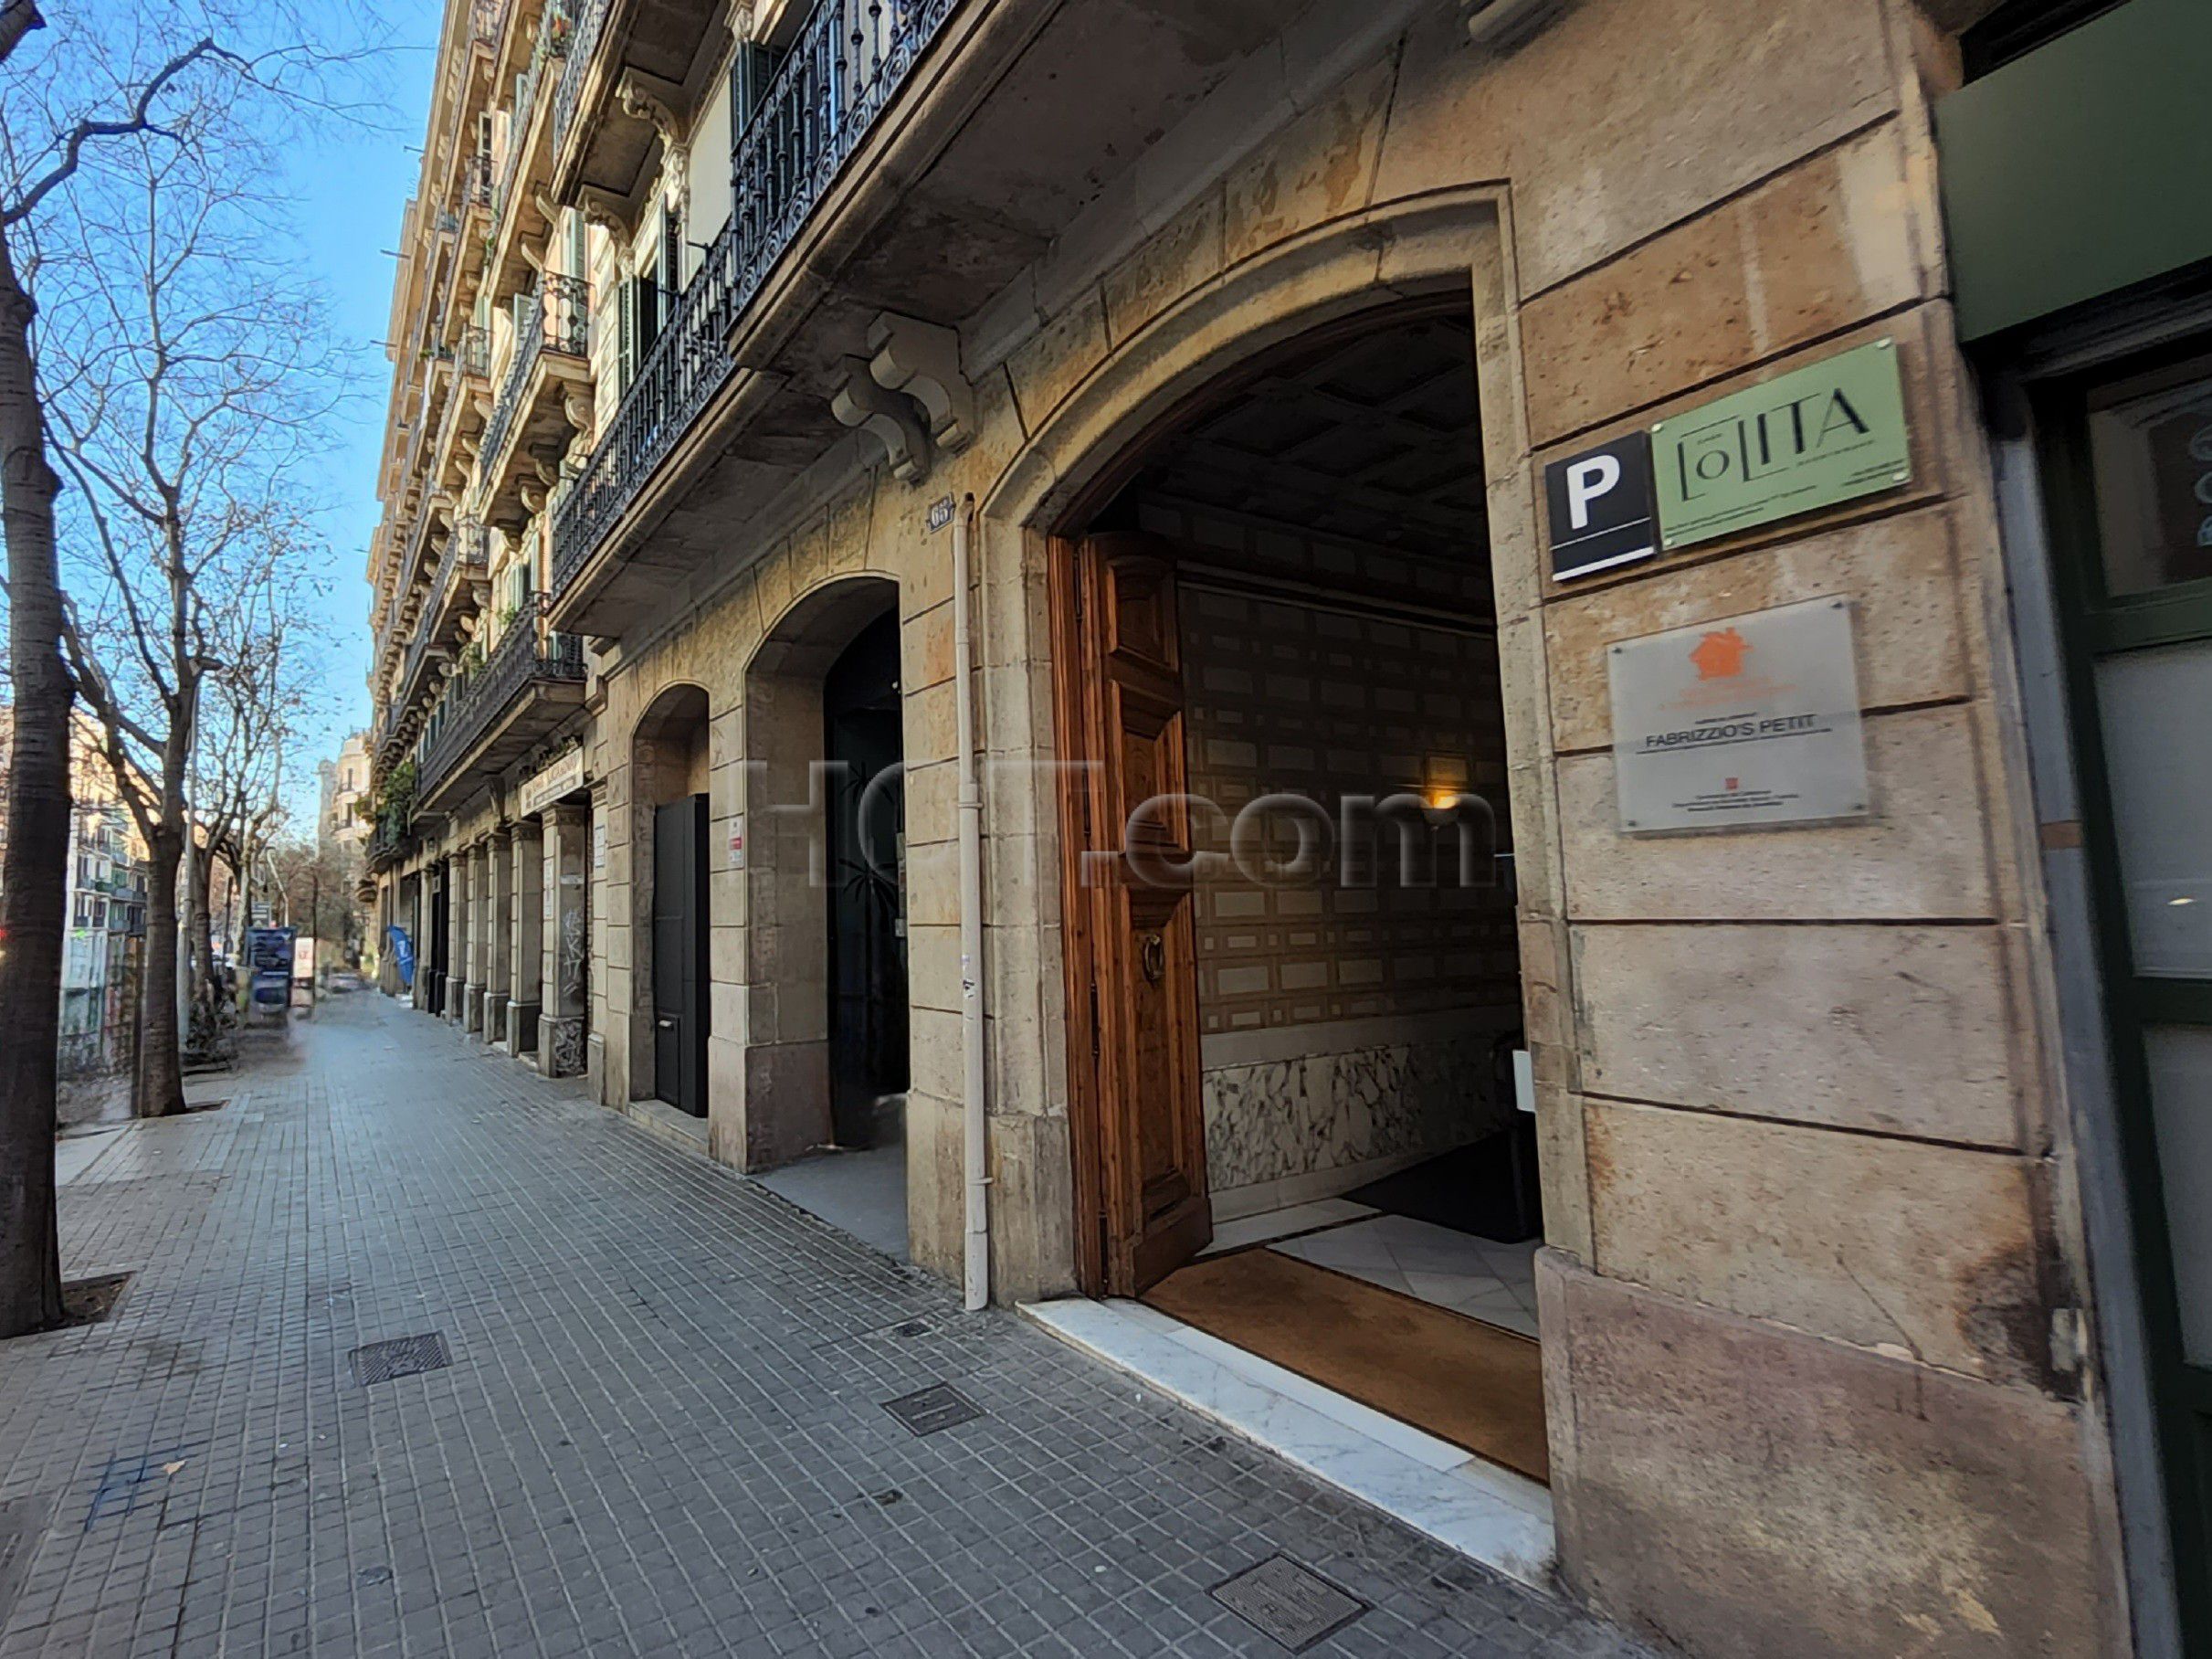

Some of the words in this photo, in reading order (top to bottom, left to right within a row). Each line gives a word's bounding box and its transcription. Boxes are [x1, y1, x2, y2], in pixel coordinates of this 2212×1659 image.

[1565, 454, 1621, 530] P
[1646, 722, 1755, 747] FABRIZZIO'S
[1759, 713, 1817, 734] PETIT
